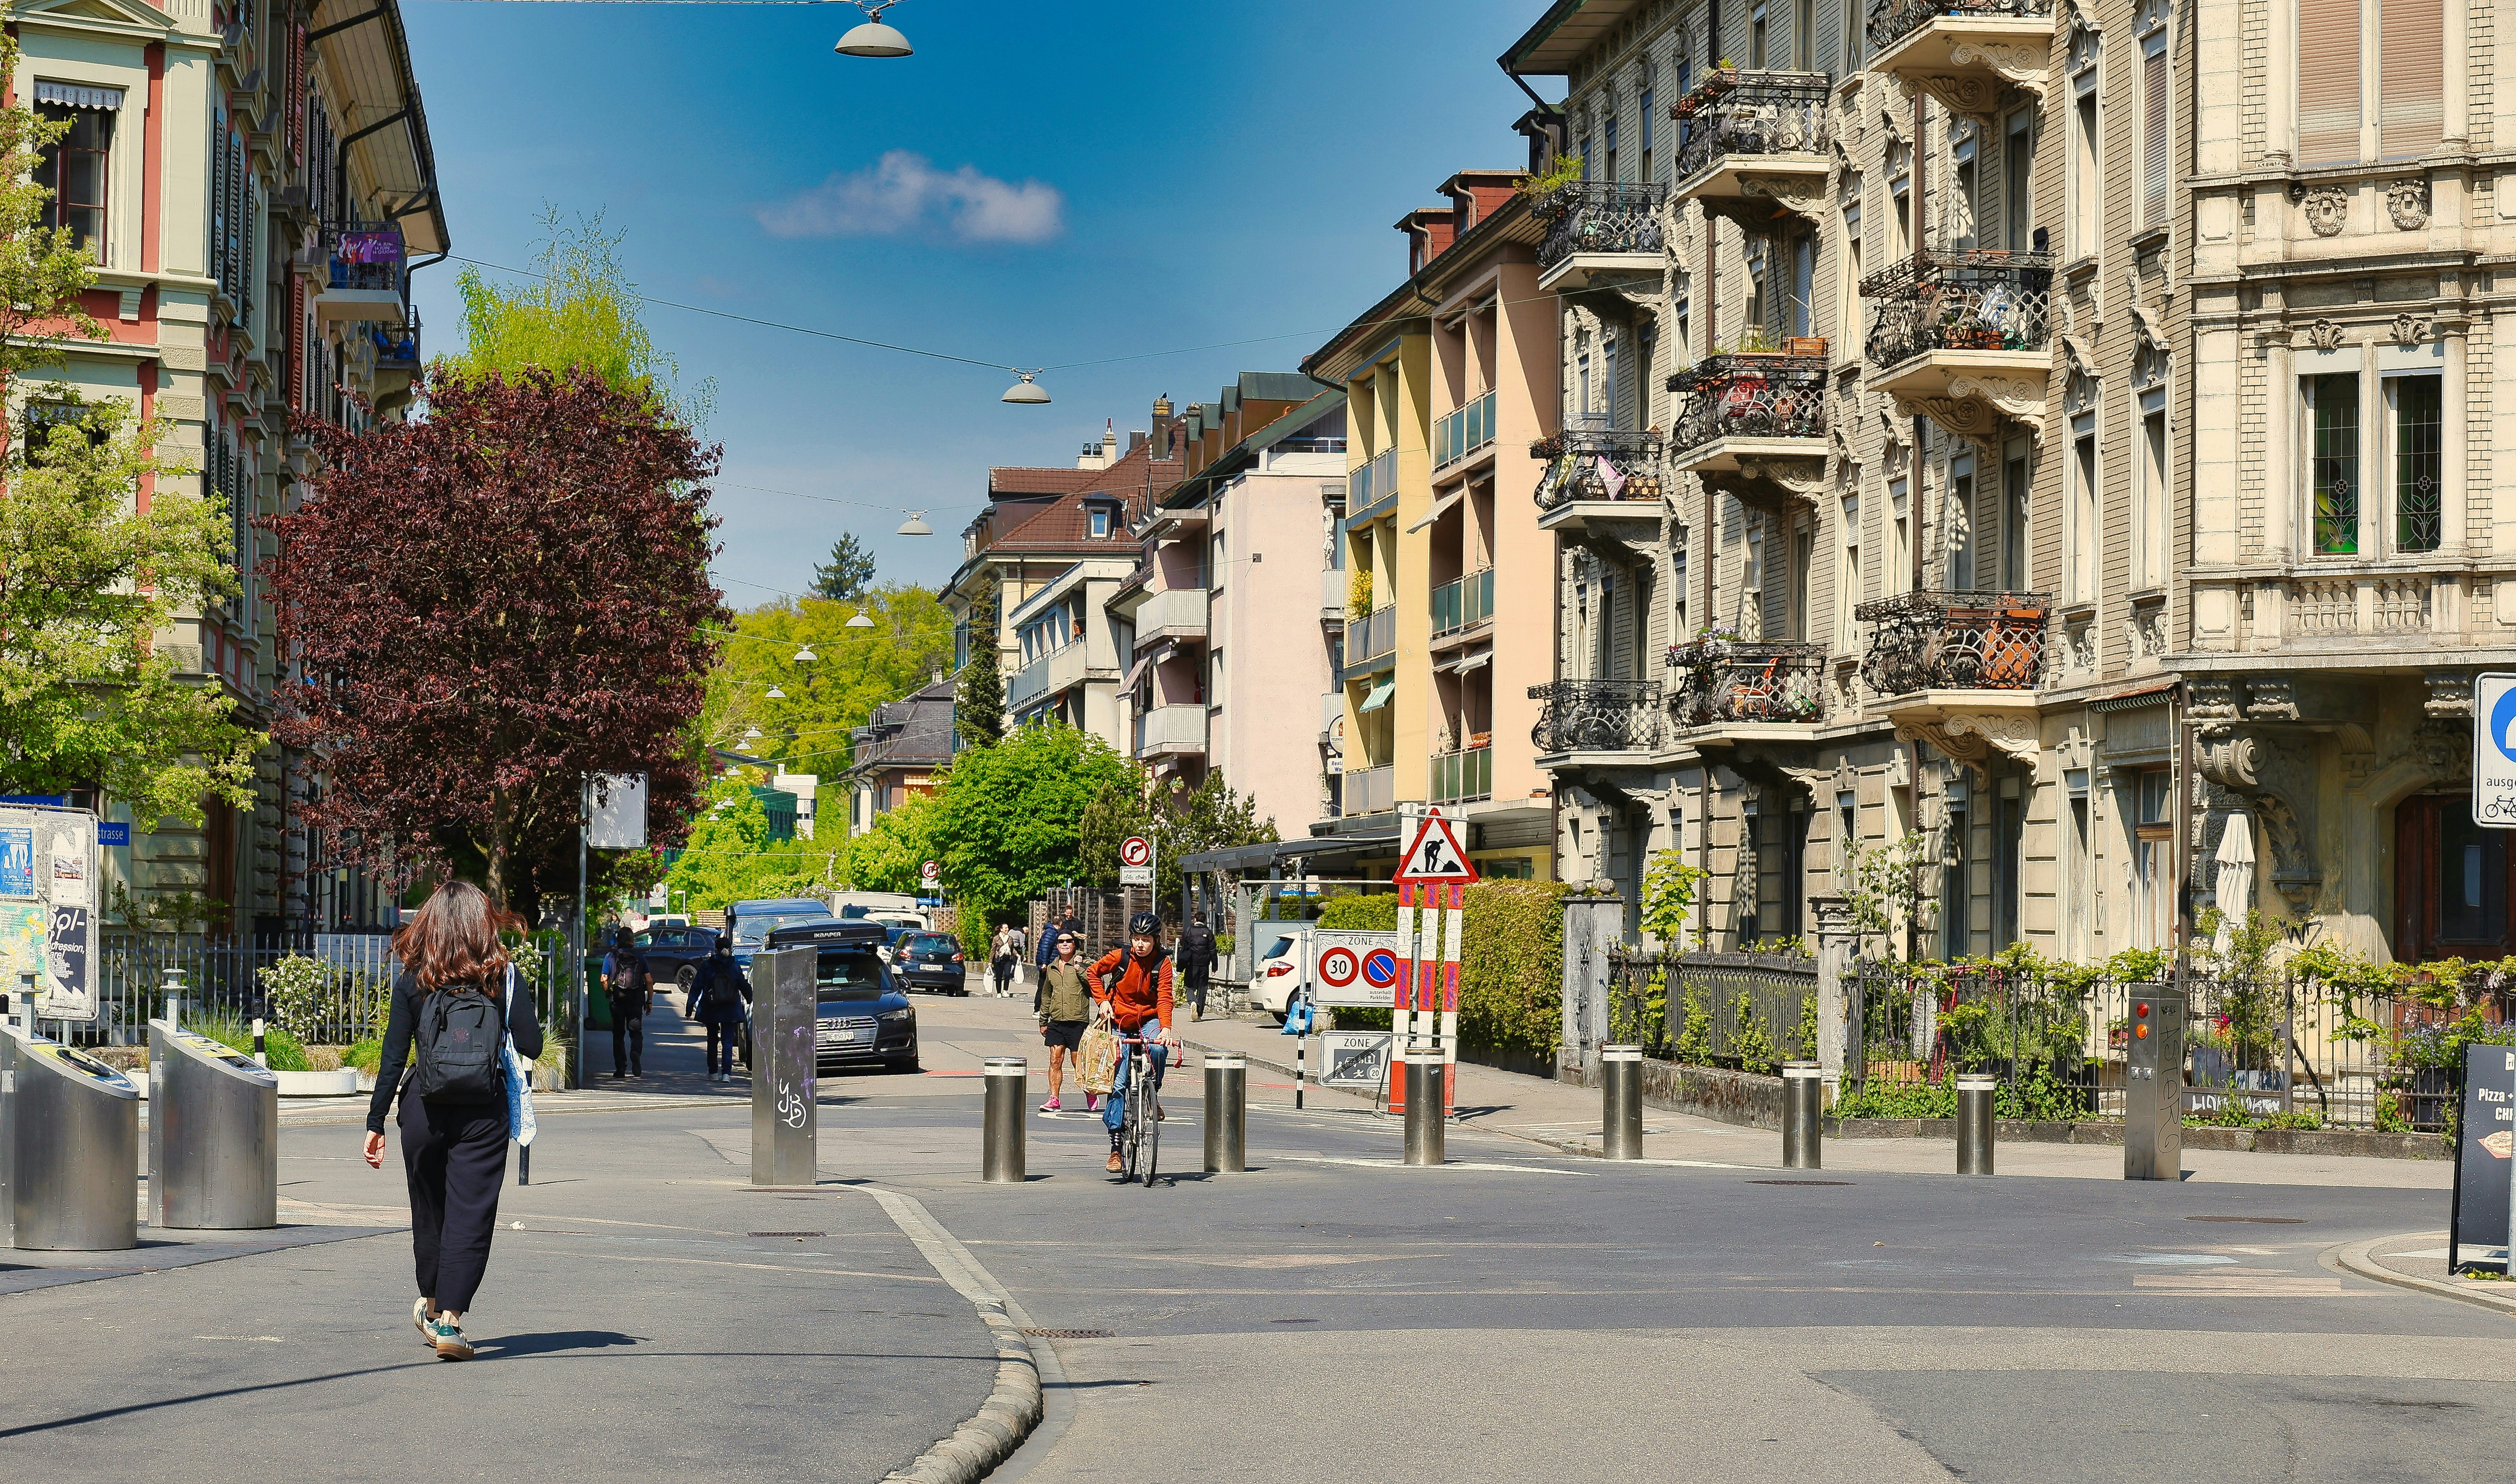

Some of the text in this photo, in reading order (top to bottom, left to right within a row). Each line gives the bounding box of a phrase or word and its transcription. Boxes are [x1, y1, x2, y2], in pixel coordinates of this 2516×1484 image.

[1348, 937, 1373, 945] ZONE
[1330, 960, 1347, 974] 30
[1344, 1038, 1370, 1048] ZONE
[2478, 1088, 2506, 1103] Pizza
